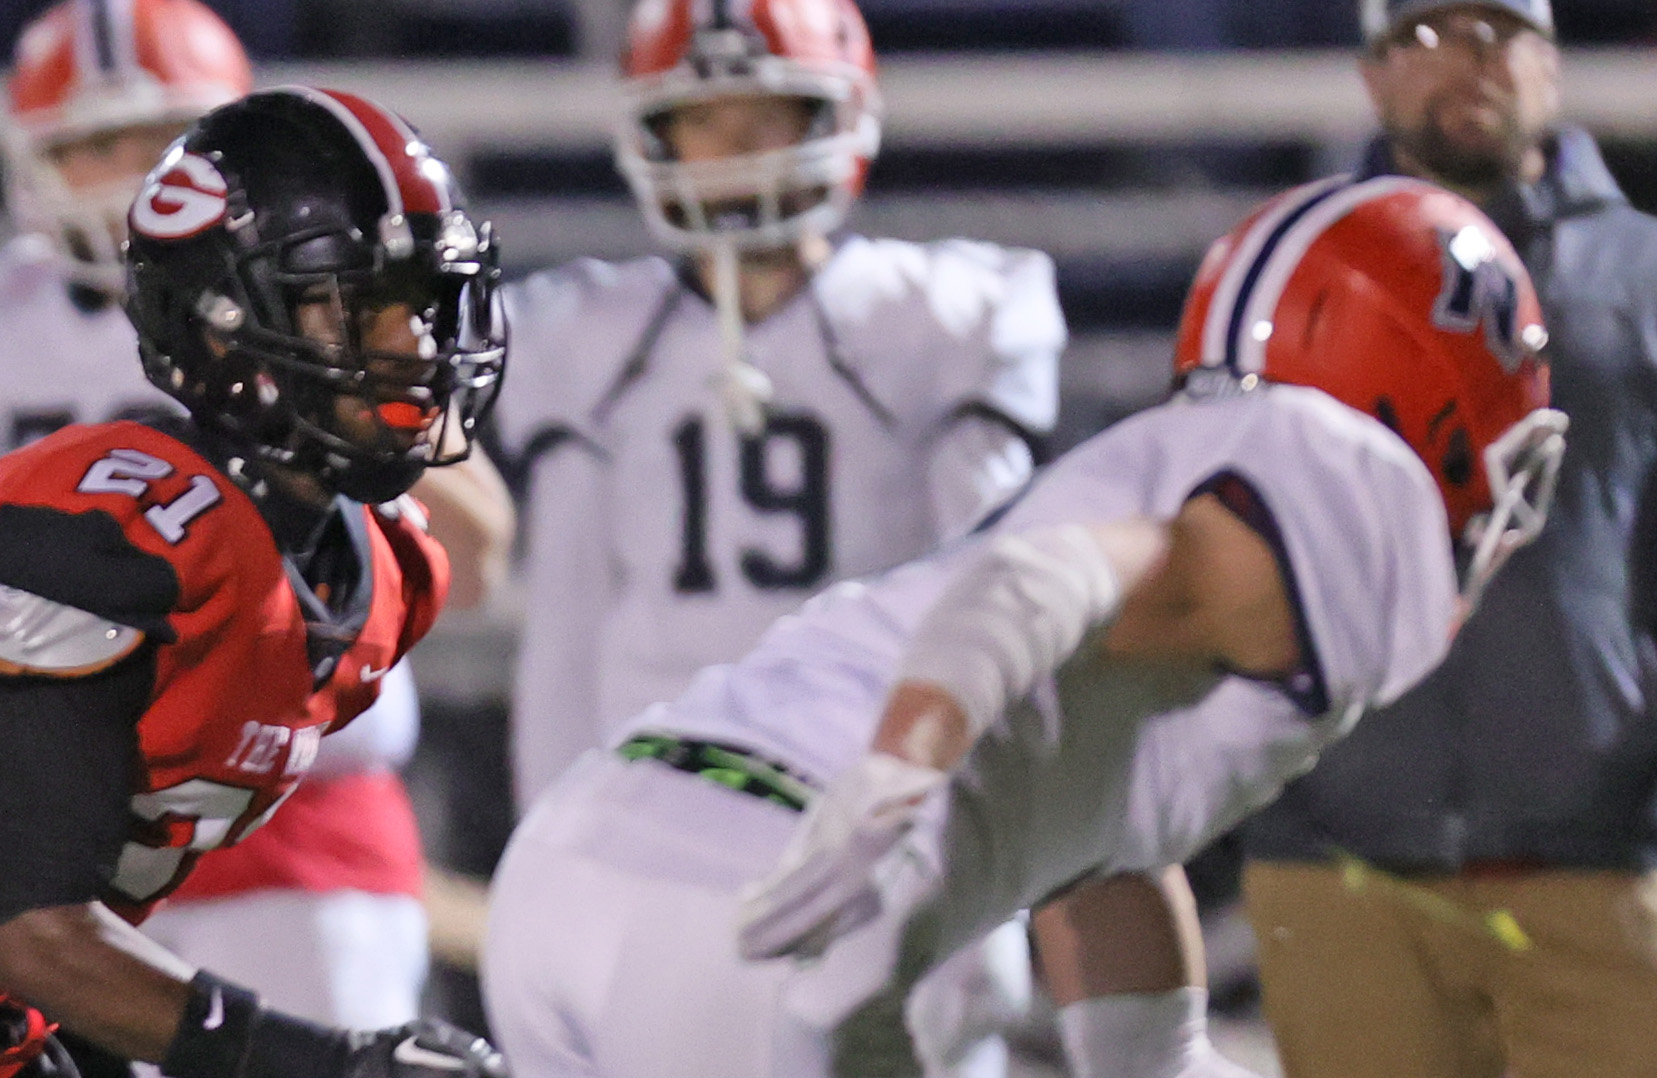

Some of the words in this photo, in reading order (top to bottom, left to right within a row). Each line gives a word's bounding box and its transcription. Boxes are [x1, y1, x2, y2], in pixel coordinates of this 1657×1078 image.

[129, 150, 230, 240] G
[76, 448, 226, 545] 21
[671, 412, 830, 592] 19
